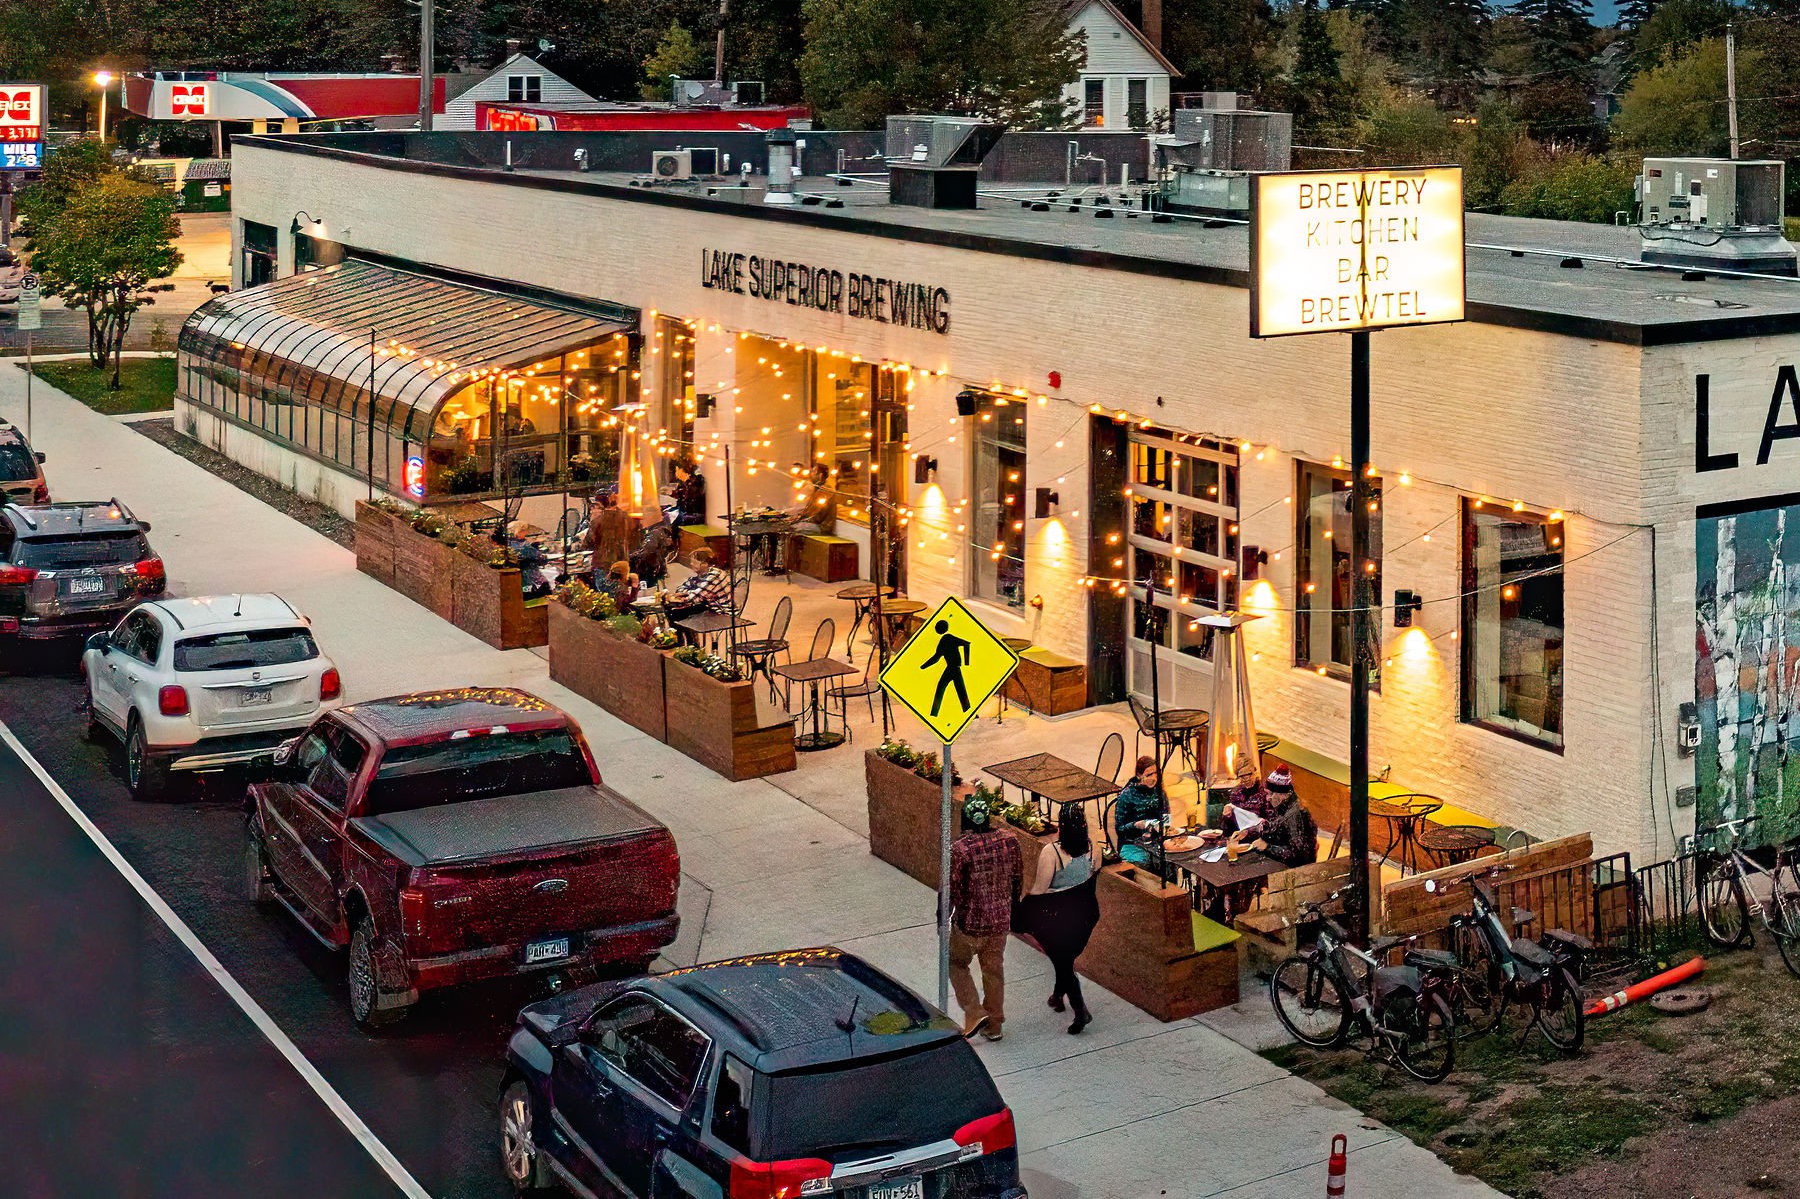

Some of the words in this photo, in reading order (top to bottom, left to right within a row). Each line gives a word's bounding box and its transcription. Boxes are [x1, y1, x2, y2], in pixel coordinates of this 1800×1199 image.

[4, 143, 37, 154] MILK
[1299, 178, 1427, 209] BREWERY
[1306, 217, 1418, 248] KITCHEN
[1338, 256, 1389, 283] BAR
[702, 248, 746, 294] LAKE
[749, 255, 843, 314] SUPERIOR
[848, 272, 951, 334] BREWING
[1301, 291, 1427, 324] BREWTEL
